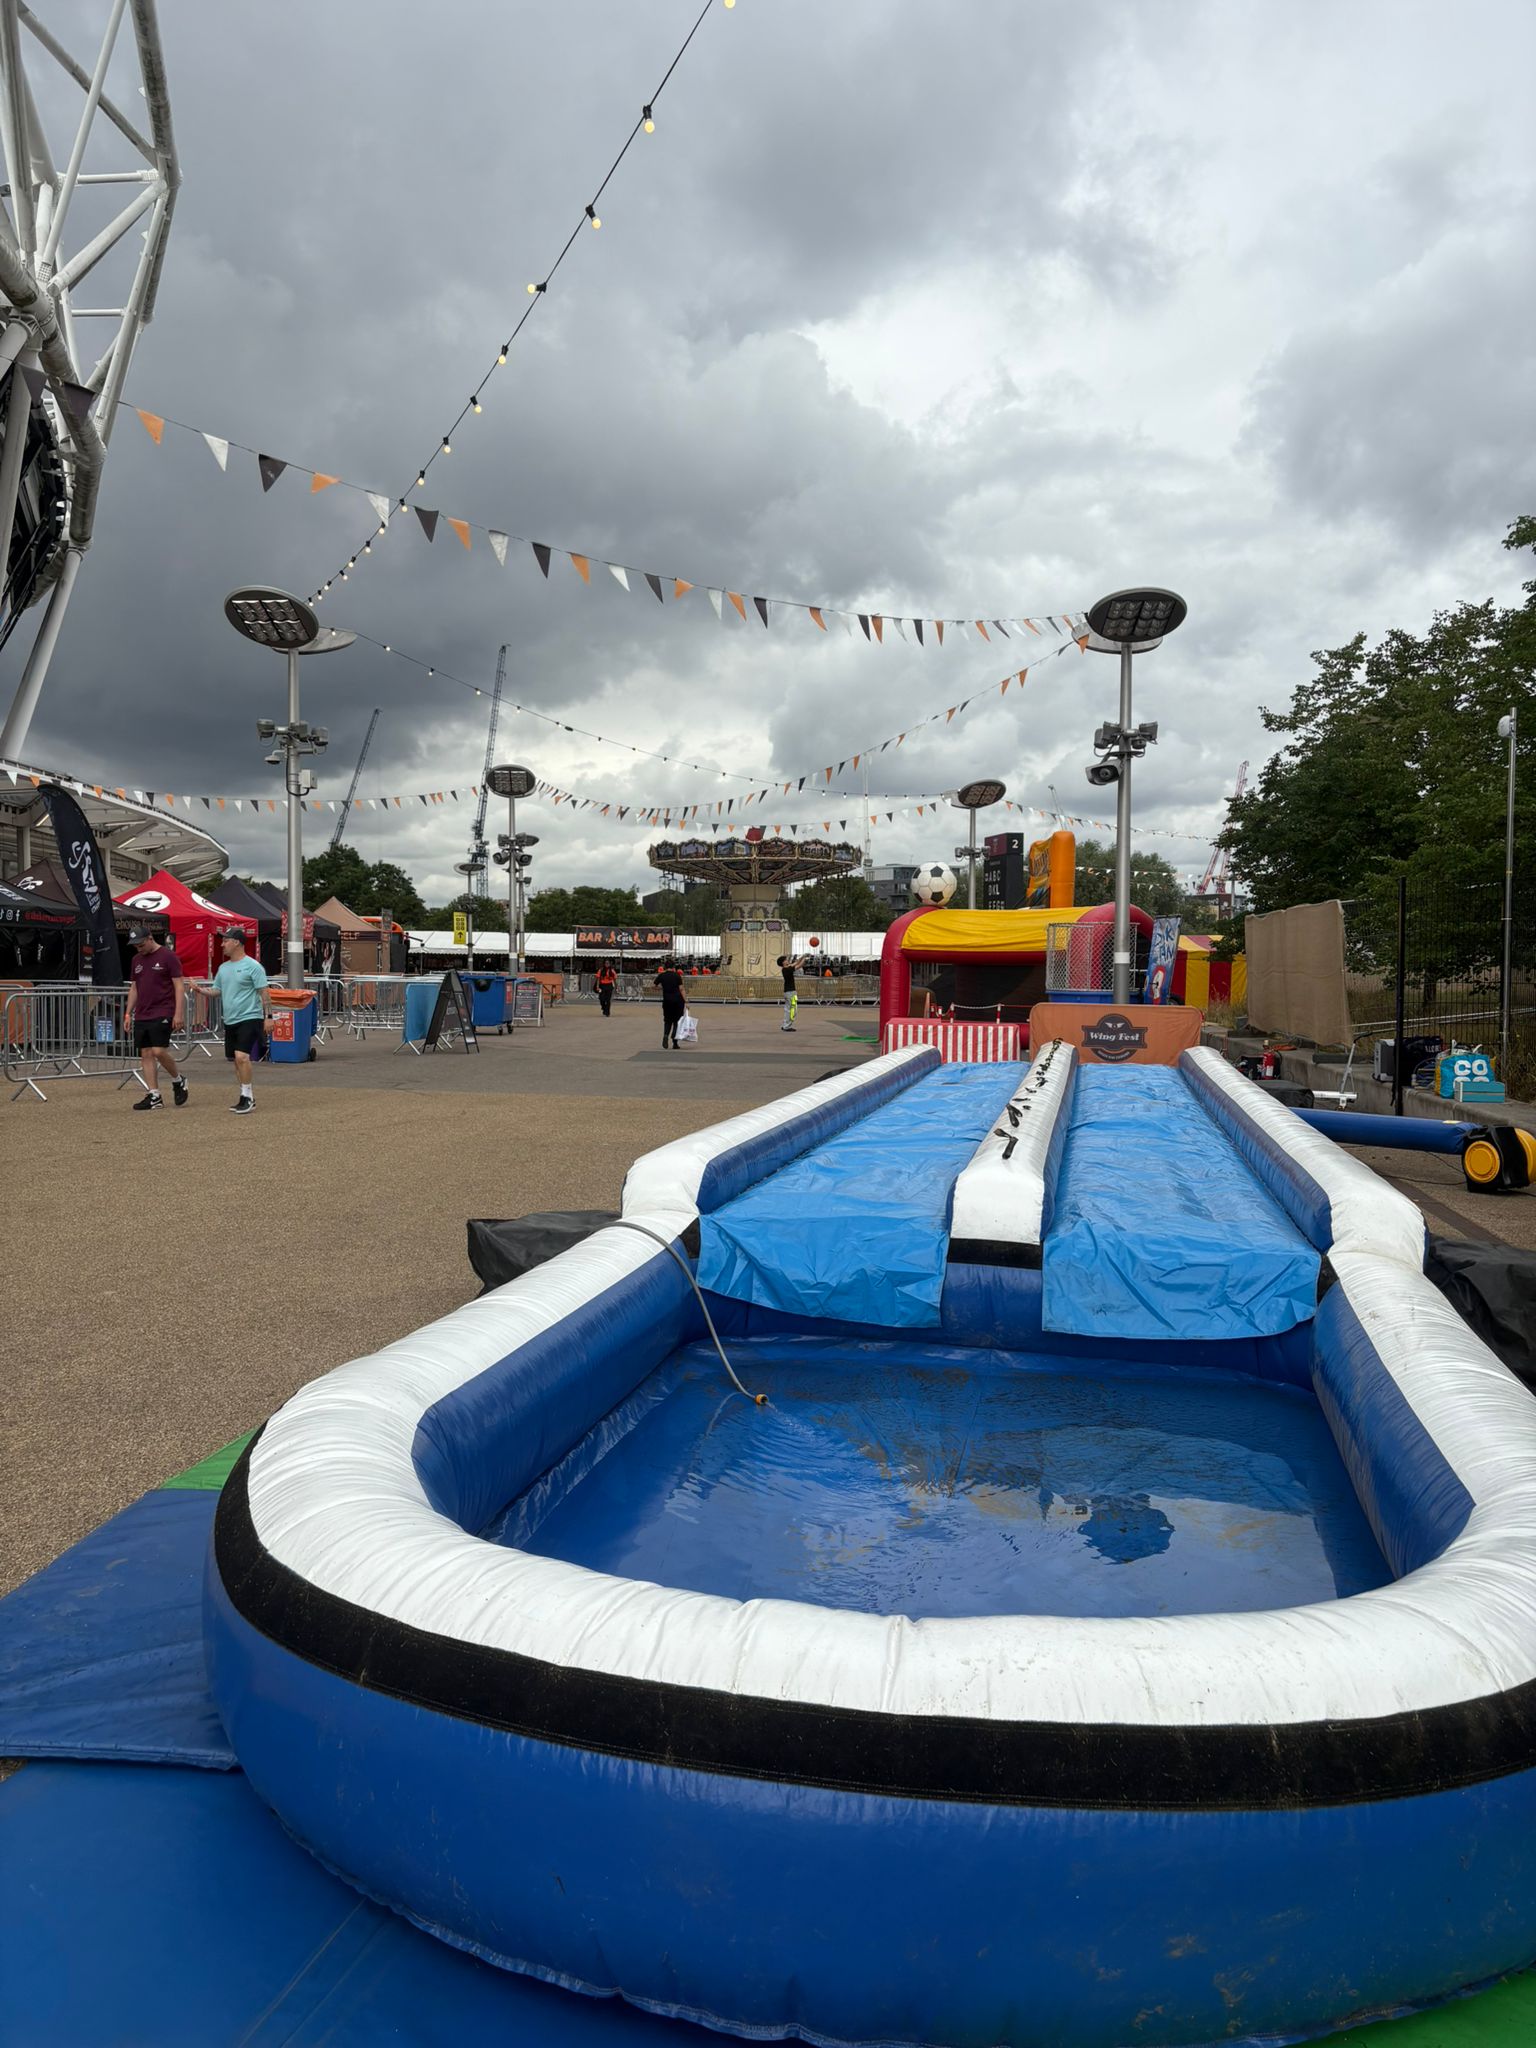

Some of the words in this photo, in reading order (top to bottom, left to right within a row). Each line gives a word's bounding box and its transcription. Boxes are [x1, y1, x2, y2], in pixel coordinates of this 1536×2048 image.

[1011, 839, 1019, 849] 2
[578, 931, 602, 942] BAR
[646, 932, 670, 943] BAR
[1089, 1031, 1116, 1042] Wing
[1118, 1032, 1140, 1041] Fest
